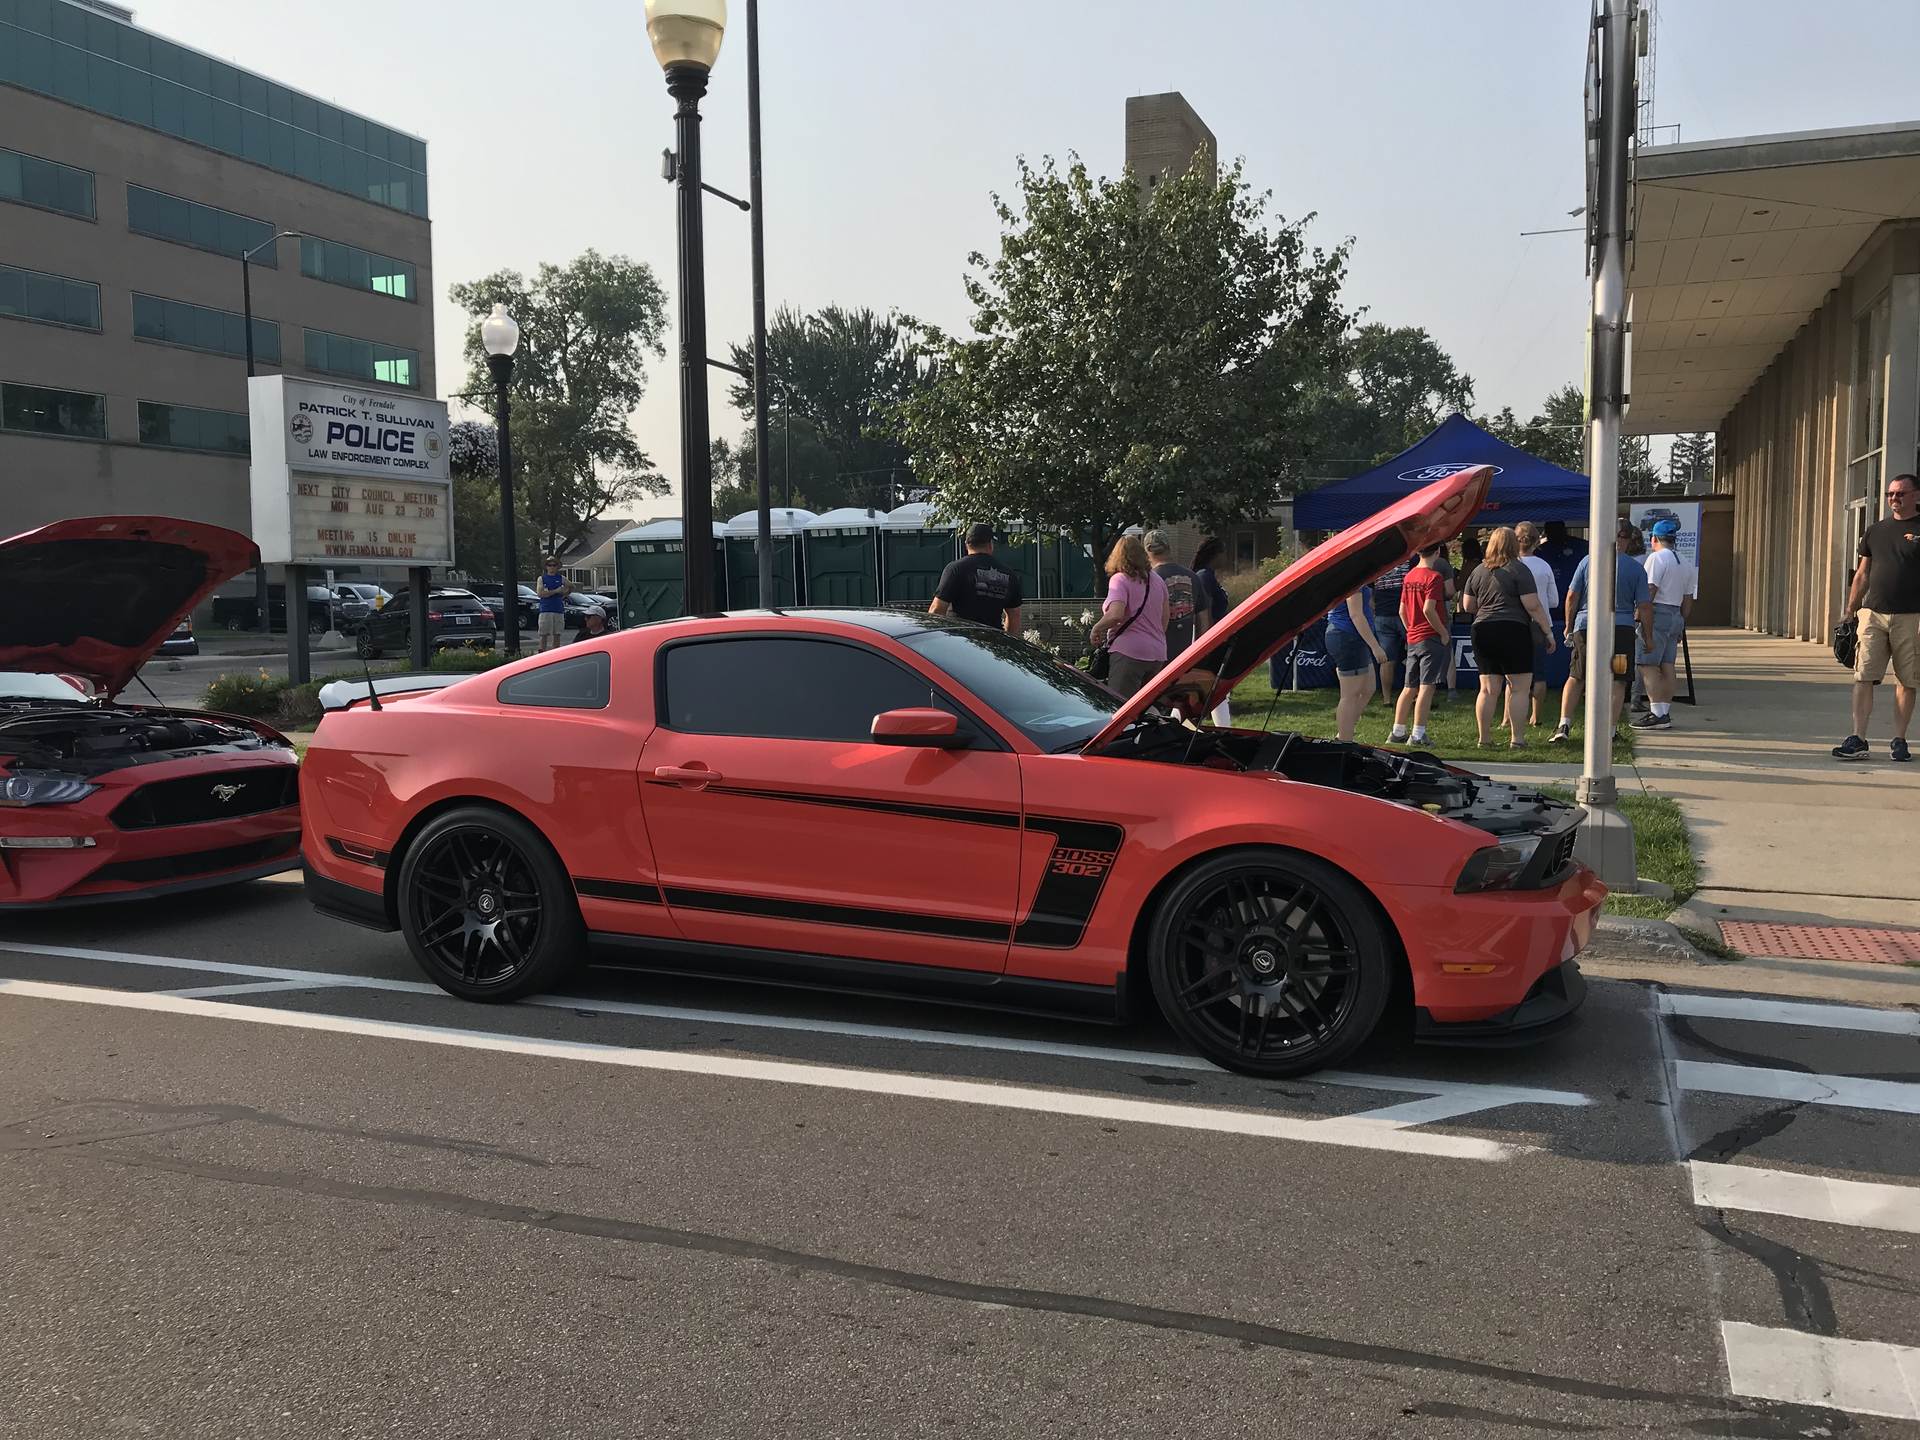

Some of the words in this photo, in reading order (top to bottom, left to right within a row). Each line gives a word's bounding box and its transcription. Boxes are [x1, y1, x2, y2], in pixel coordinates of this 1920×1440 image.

[343, 394, 356, 406] City
[359, 397, 367, 407] of
[368, 398, 396, 410] Ferndale
[299, 402, 357, 418] PATRICK
[362, 411, 372, 421] T.
[376, 413, 435, 429] SULLIVAN
[326, 421, 415, 454] POLICE
[308, 448, 328, 459] LAW
[331, 452, 391, 466] ENFORCEMENT
[393, 457, 430, 469] COMPLEX
[297, 483, 320, 497] NEXT
[331, 486, 350, 499] CITY
[361, 488, 395, 502] COUNCIL
[403, 491, 438, 505] MEETING
[330, 500, 349, 513] MON
[365, 503, 385, 515] AUG
[395, 505, 406, 516] 23
[418, 507, 435, 518] 7:00
[317, 529, 355, 542] MEETING
[368, 531, 378, 543] IS
[387, 532, 417, 544] ONLINE
[1285, 649, 1327, 667] Ford
[1052, 848, 1114, 864] BOSS
[1052, 862, 1103, 877] 302
